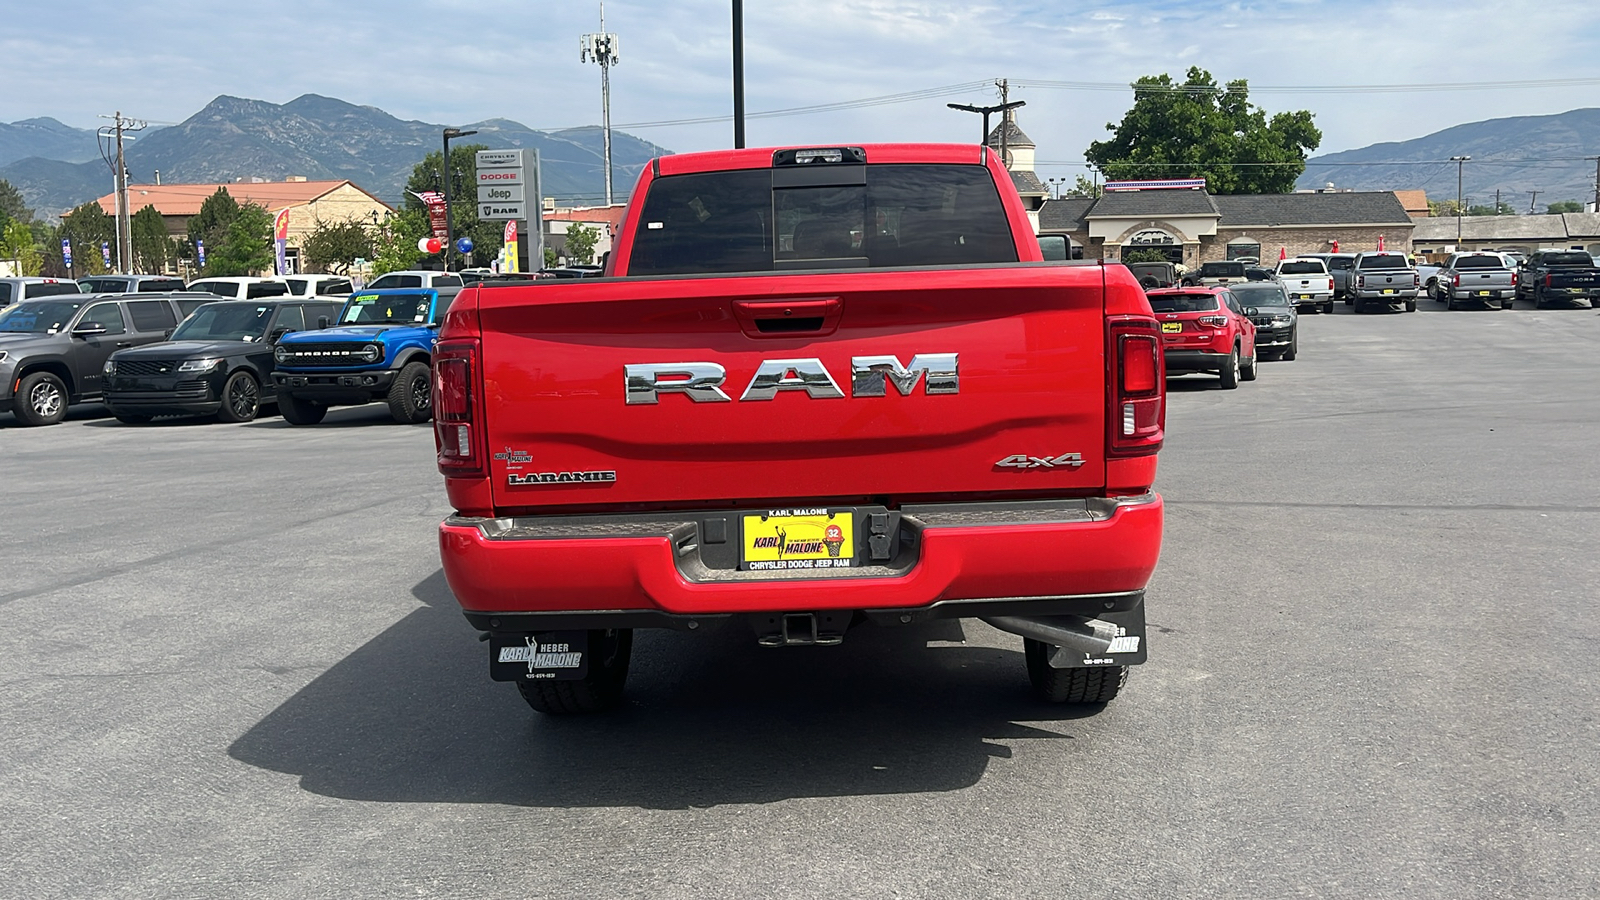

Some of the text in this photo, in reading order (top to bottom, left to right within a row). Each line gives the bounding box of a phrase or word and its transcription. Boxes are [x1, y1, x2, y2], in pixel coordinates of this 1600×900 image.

[488, 188, 511, 199] Jeep
[624, 352, 960, 405] RAM
[995, 452, 1087, 468] 4x4
[508, 470, 617, 485] LARAMIE
[793, 508, 828, 516] MALONE
[828, 529, 839, 538] 32
[753, 537, 778, 548] KARL
[784, 542, 824, 554] MALONE
[749, 558, 850, 570] CHRYSLER DODGE JEEP RAM
[498, 647, 529, 662] KARL
[540, 644, 569, 653] HEBER
[534, 653, 582, 668] MALONE
